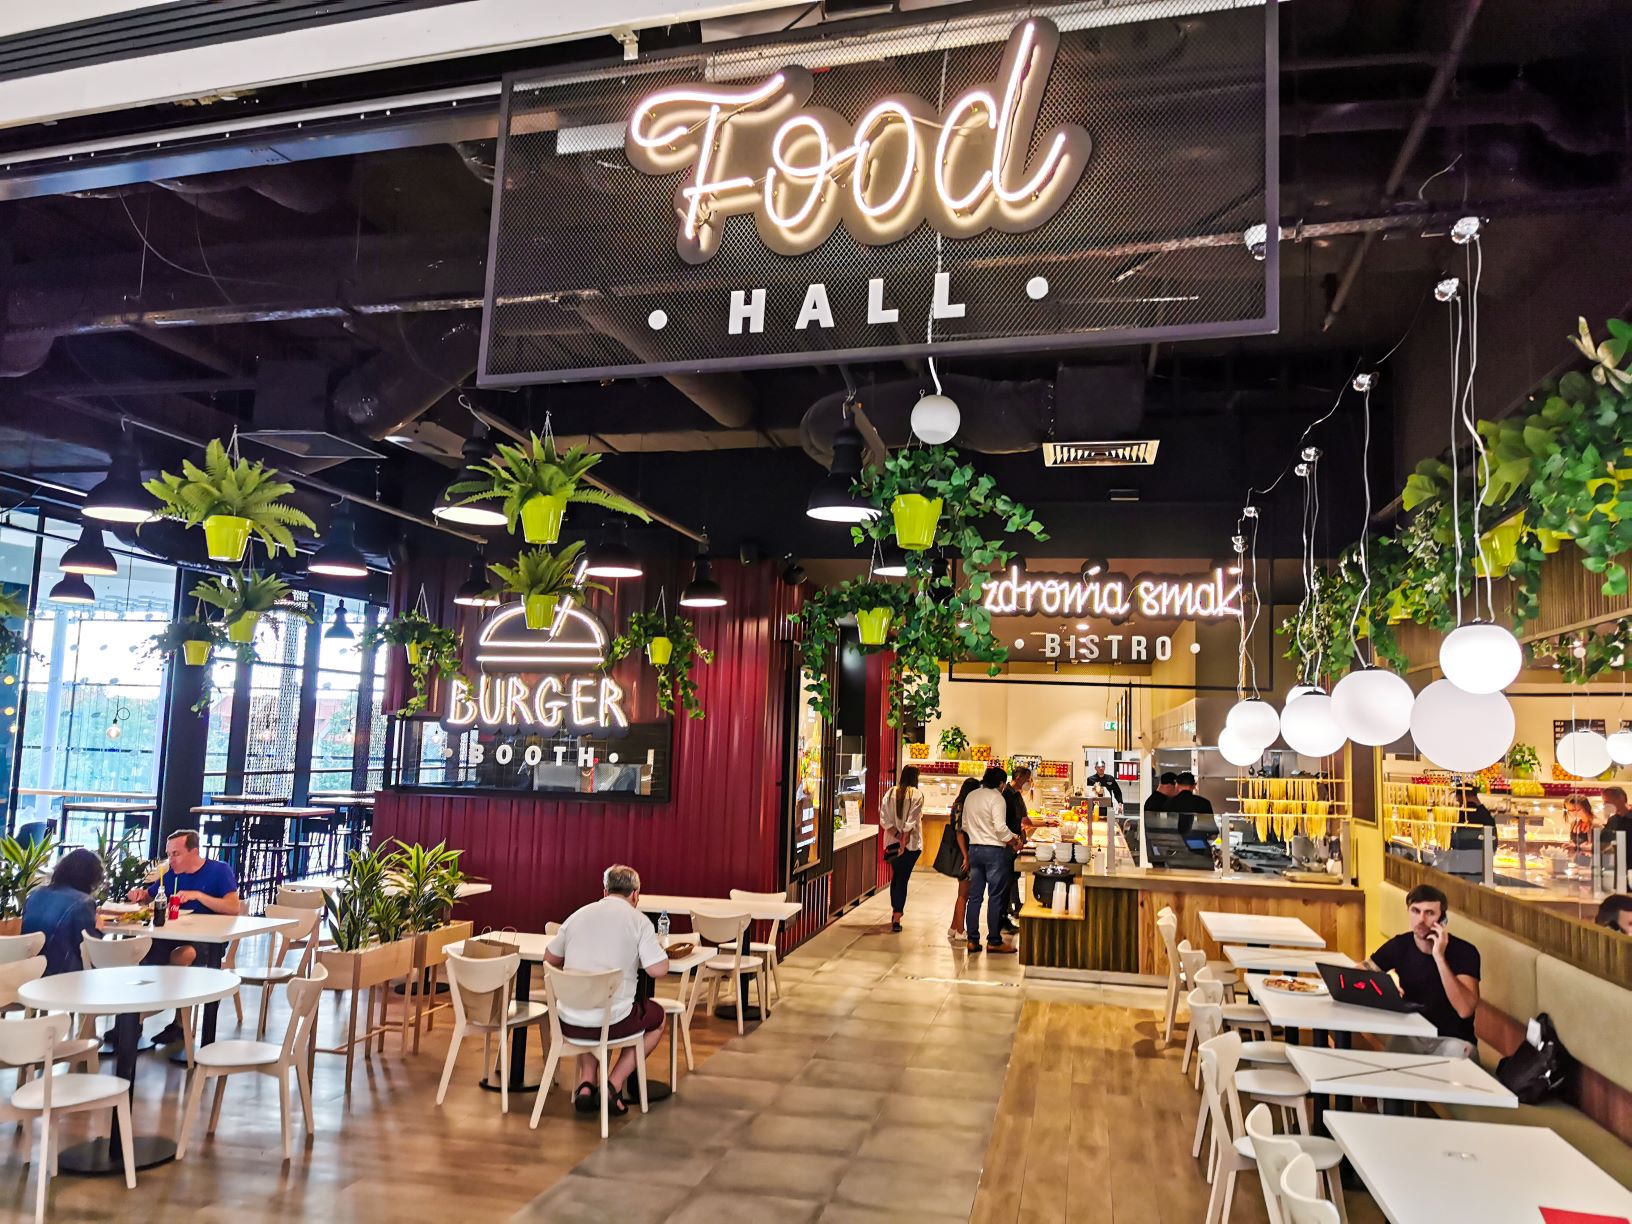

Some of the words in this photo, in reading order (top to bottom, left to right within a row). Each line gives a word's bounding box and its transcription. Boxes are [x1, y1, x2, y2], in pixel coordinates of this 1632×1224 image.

[630, 21, 1068, 242] Food
[728, 272, 967, 335] HALL
[982, 565, 1132, 615] zdrowia
[1137, 568, 1243, 616] smak
[1045, 634, 1172, 661] BISTRO
[446, 675, 628, 728] BURGER
[469, 743, 594, 768] BOOTH
